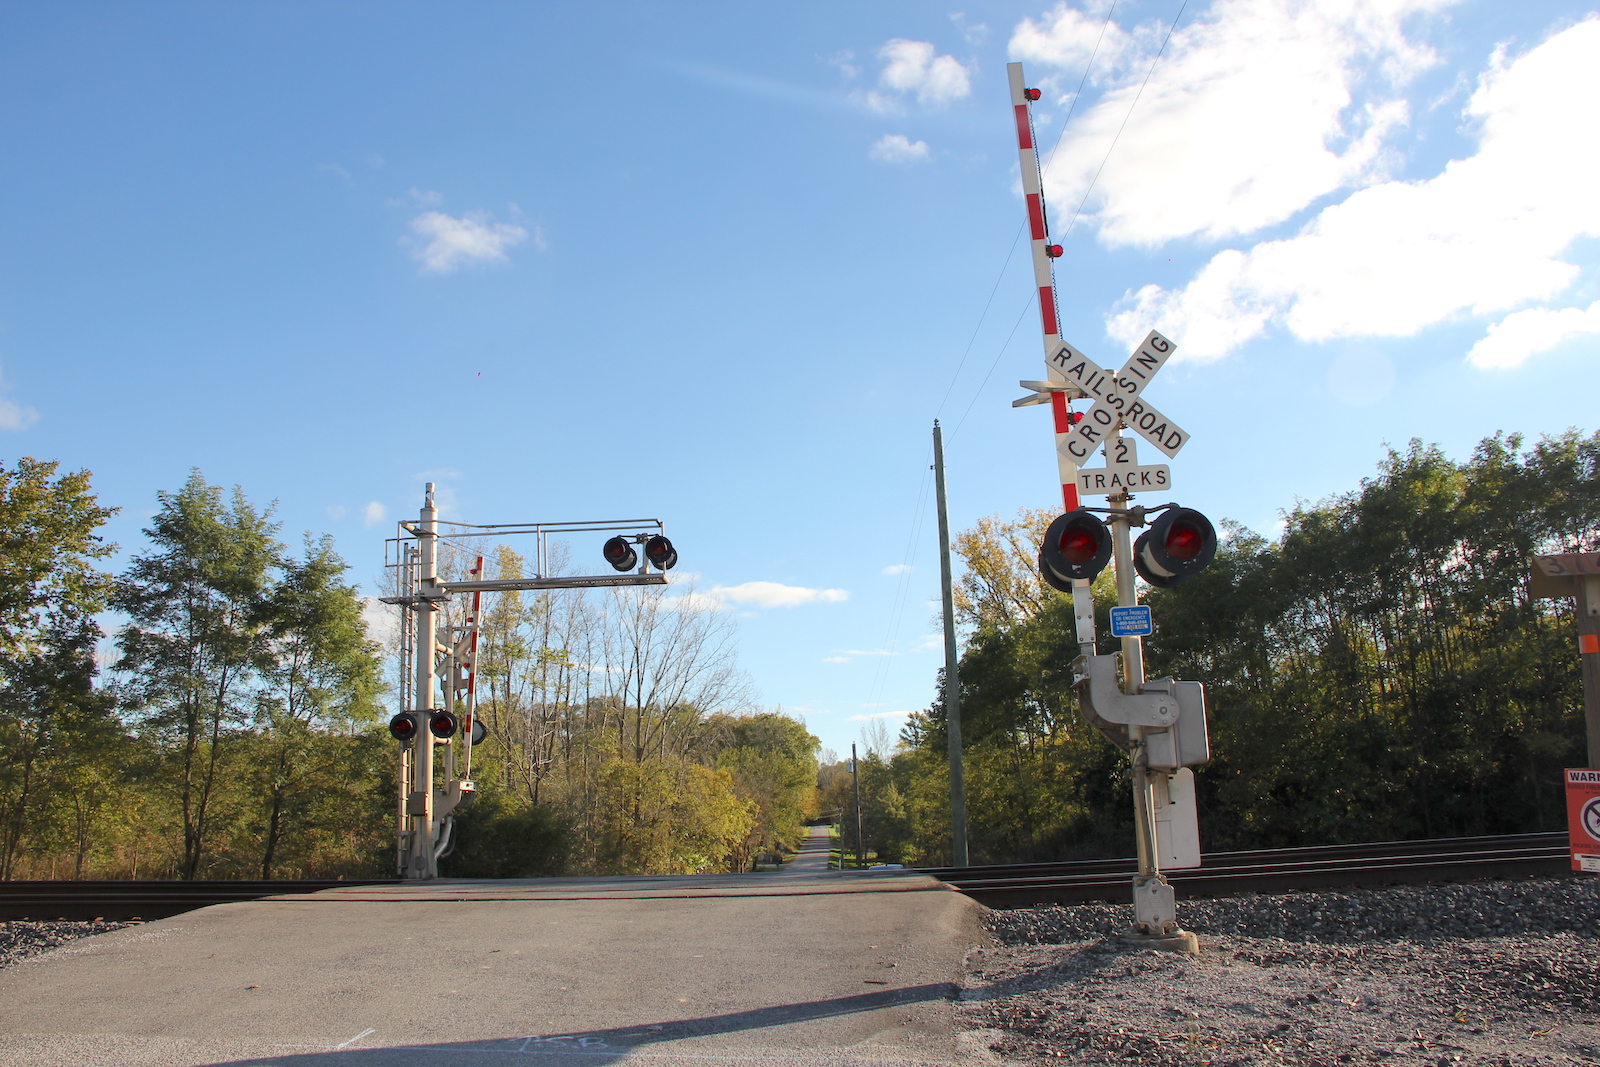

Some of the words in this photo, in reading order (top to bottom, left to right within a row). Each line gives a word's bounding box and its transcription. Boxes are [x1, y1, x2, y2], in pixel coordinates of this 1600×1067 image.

[1053, 347, 1106, 396] RAIL
[1125, 401, 1182, 450] ROAD
[1068, 336, 1169, 458] CROSSING
[1081, 470, 1166, 488] TRACKS
[1115, 444, 1129, 463] 2
